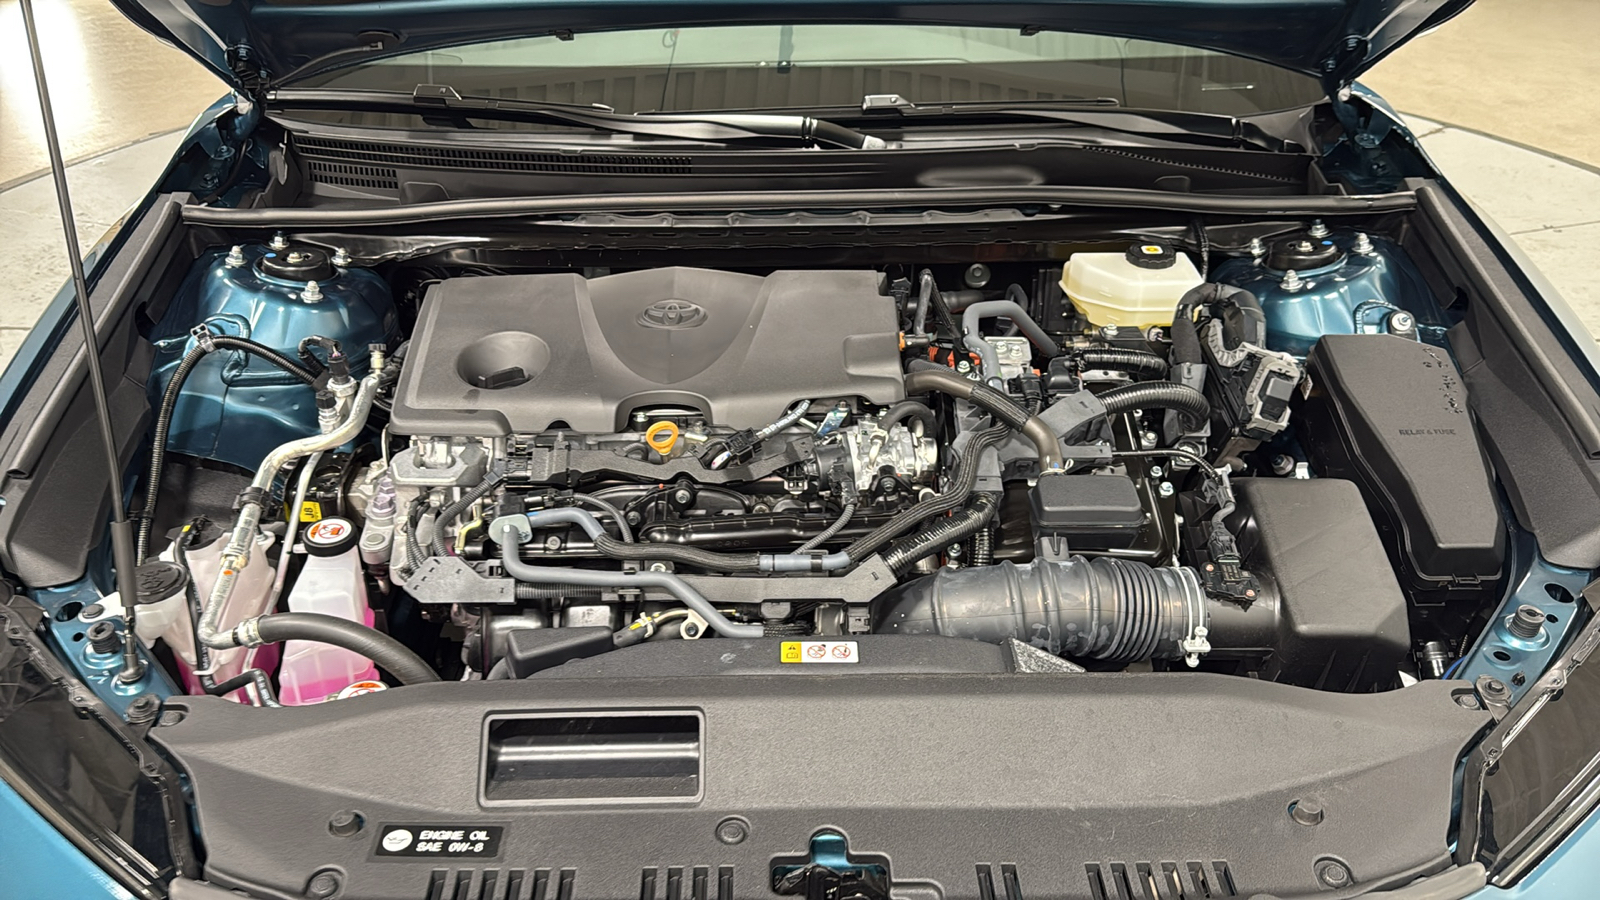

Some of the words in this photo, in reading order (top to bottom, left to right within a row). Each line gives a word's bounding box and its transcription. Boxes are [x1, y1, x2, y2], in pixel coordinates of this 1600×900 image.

[419, 830, 465, 840] ENGINE
[469, 830, 490, 840] OIL
[416, 842, 442, 852] SAE
[448, 842, 484, 852] 0W-8
